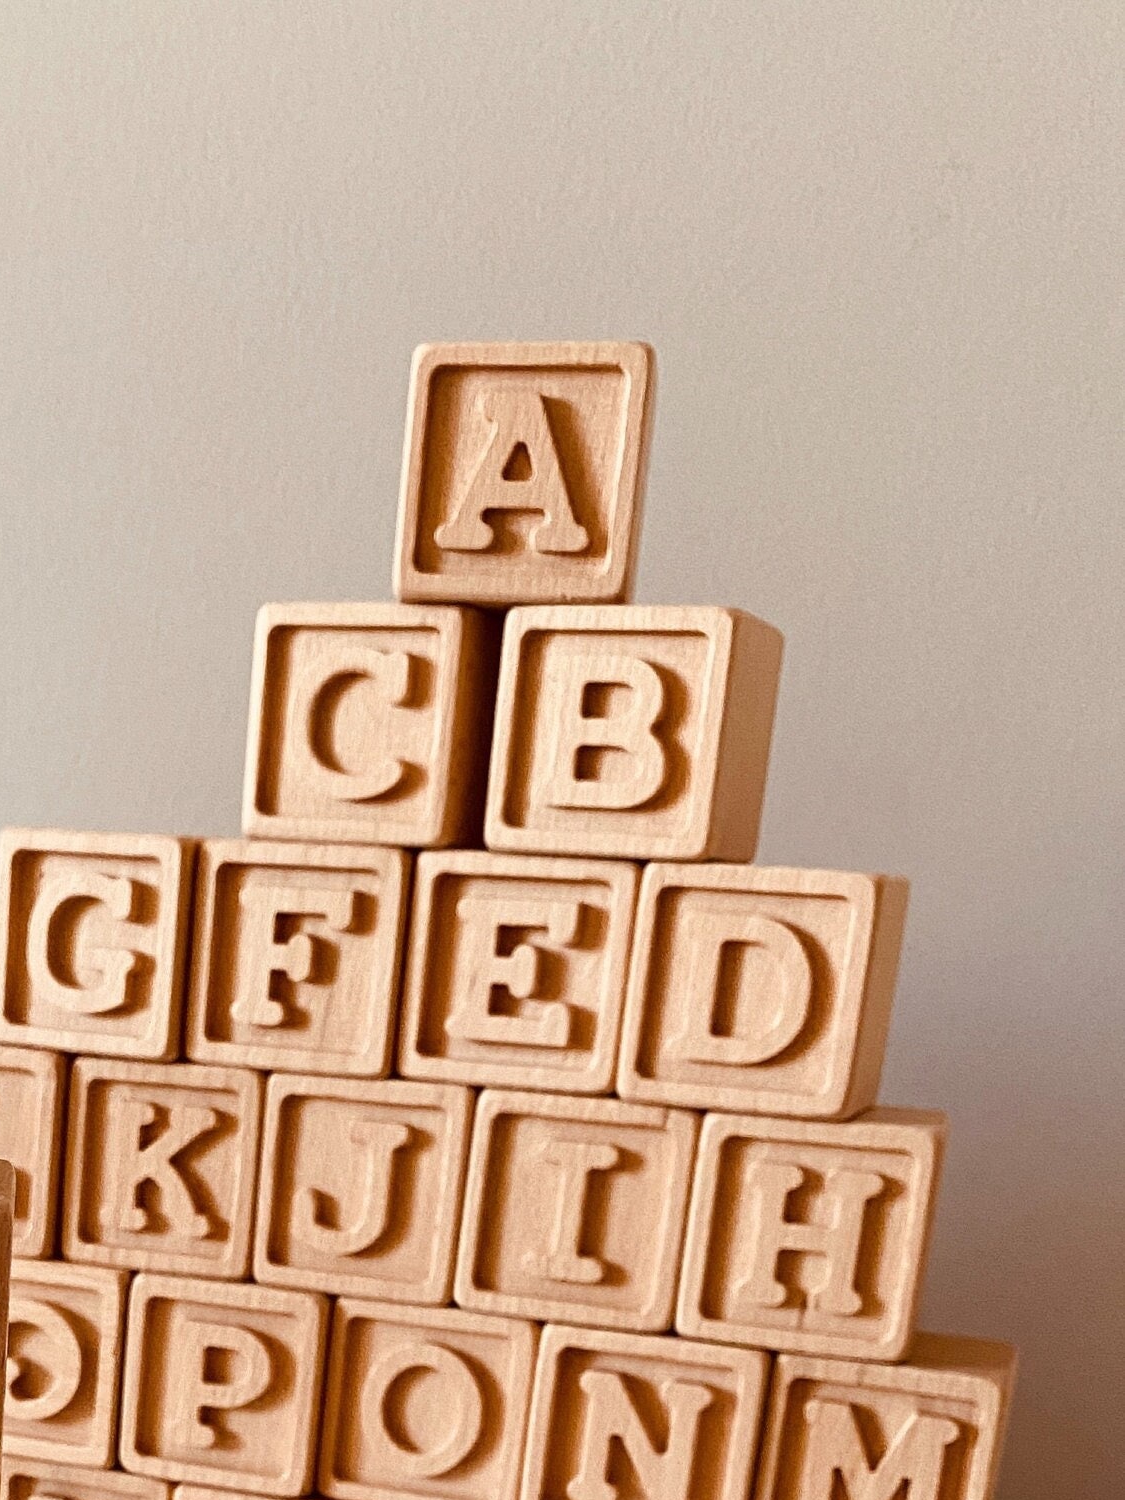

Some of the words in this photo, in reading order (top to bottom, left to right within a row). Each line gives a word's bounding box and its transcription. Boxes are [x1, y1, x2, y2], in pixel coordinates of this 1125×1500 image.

[434, 390, 589, 553] A
[283, 646, 411, 802] C
[528, 652, 666, 808] B
[27, 873, 135, 1013] G
[230, 887, 355, 1026] F
[444, 897, 579, 1047] E
[664, 909, 812, 1065] D
[97, 1087, 216, 1238] K
[293, 1120, 408, 1256] J
[521, 1141, 619, 1283] I
[732, 1160, 884, 1316] H
[174, 1323, 271, 1448] P
[362, 1342, 482, 1477] O
